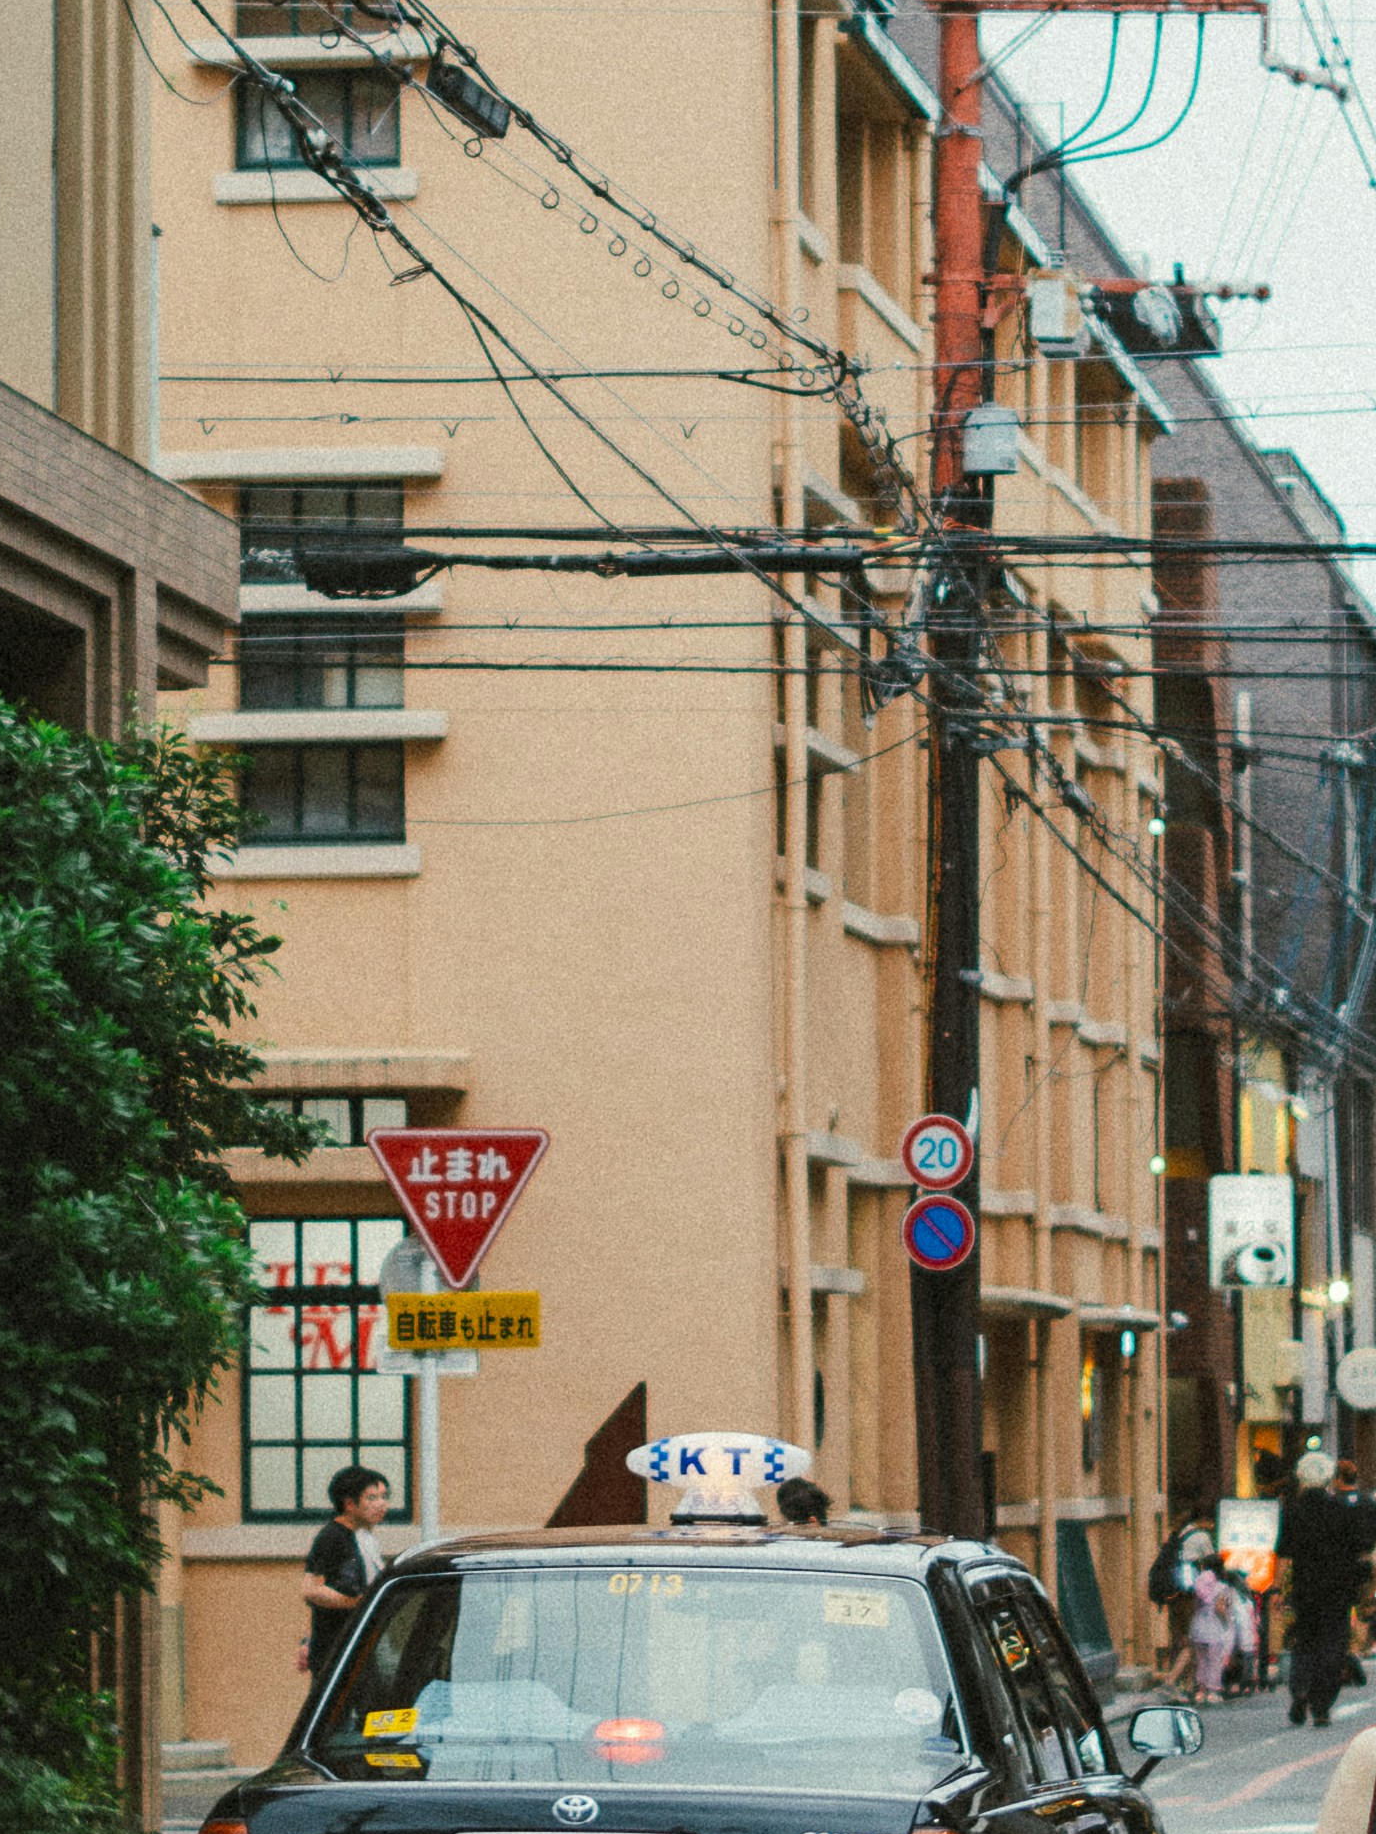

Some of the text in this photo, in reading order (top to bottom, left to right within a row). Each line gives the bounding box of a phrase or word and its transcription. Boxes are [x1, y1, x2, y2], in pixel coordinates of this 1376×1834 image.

[407, 1147, 511, 1182] 止まれ
[918, 1137, 957, 1169] 20
[426, 1191, 496, 1219] STOP
[397, 1309, 534, 1341] 自転車も止まれ
[608, 1573, 684, 1598] 0713
